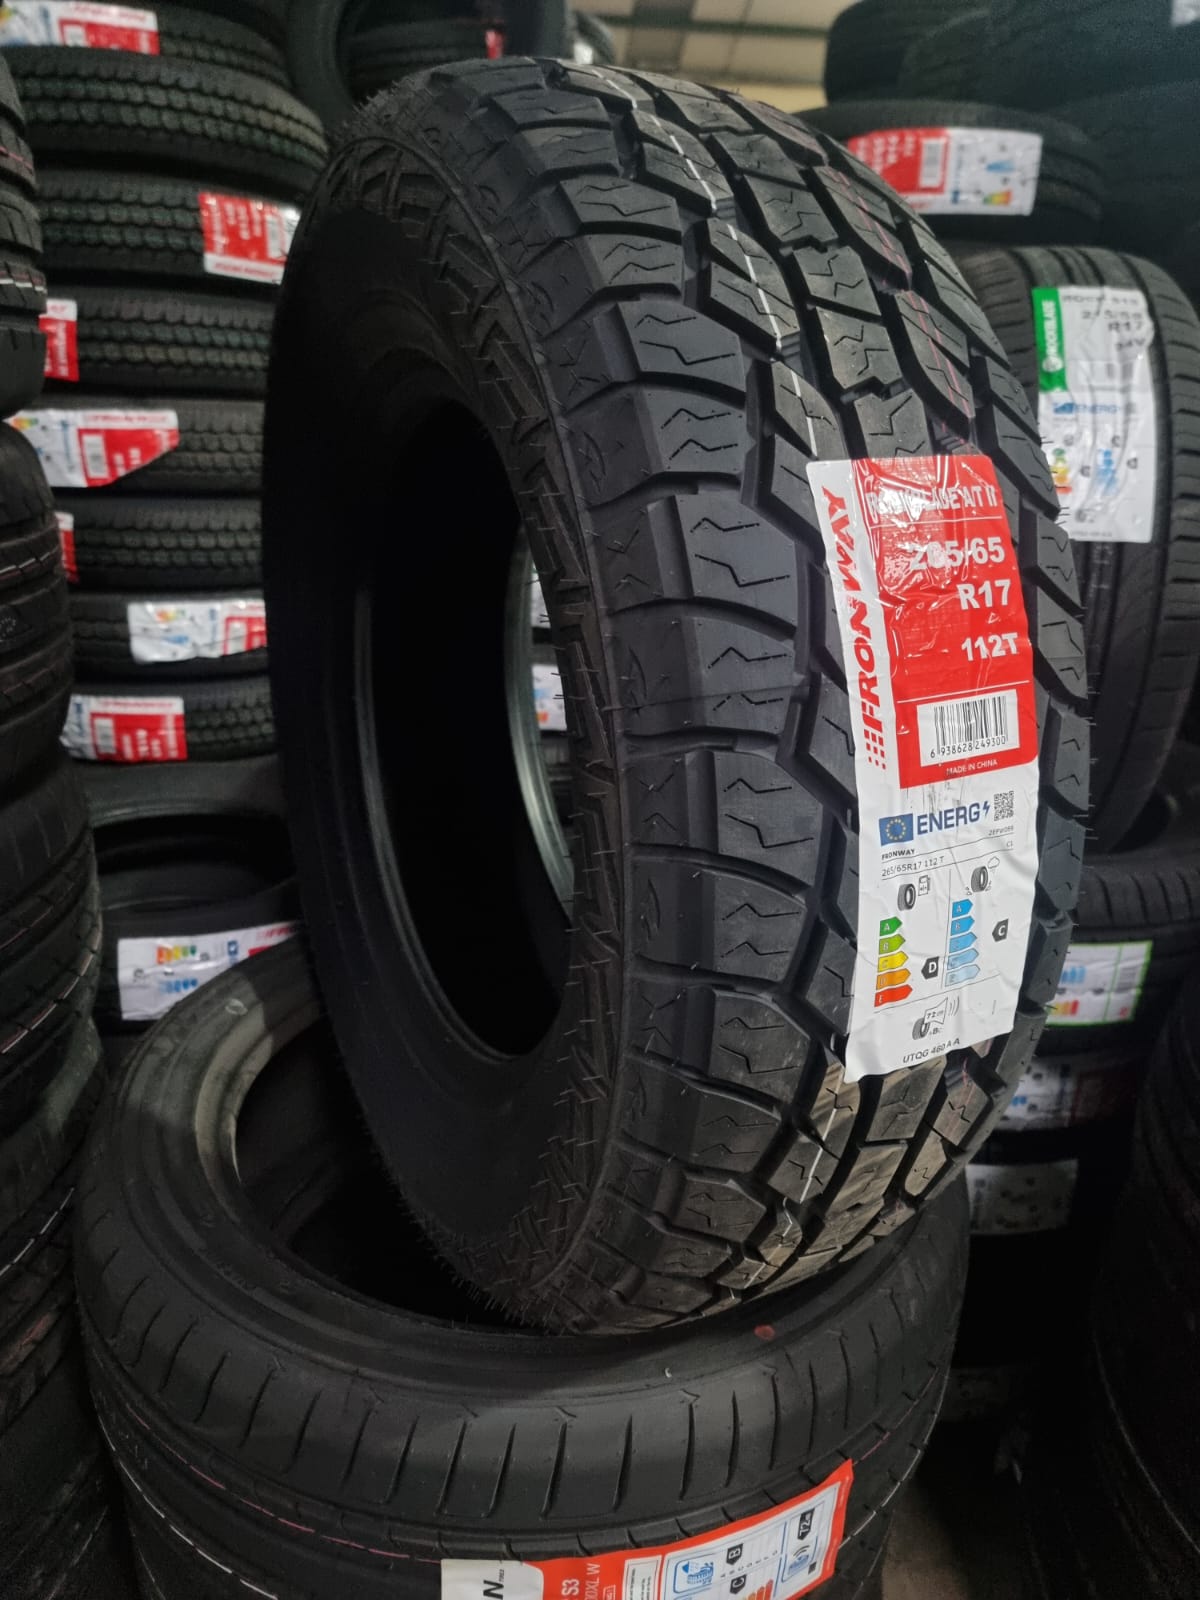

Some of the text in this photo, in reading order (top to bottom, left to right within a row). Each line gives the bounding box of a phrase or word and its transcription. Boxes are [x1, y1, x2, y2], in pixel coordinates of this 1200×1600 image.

[956, 578, 1011, 610] R17
[822, 485, 884, 737] FRONWAY
[961, 632, 1018, 662] 112T
[946, 759, 998, 776] MADE IN CHINA
[917, 802, 981, 835] ENERG
[881, 848, 915, 860] FRONWAY
[903, 1049, 929, 1063] UTQG
[728, 1549, 741, 1559] B
[586, 1562, 600, 1575] W
[561, 1578, 580, 1596] S3
[732, 1578, 745, 1588] C
